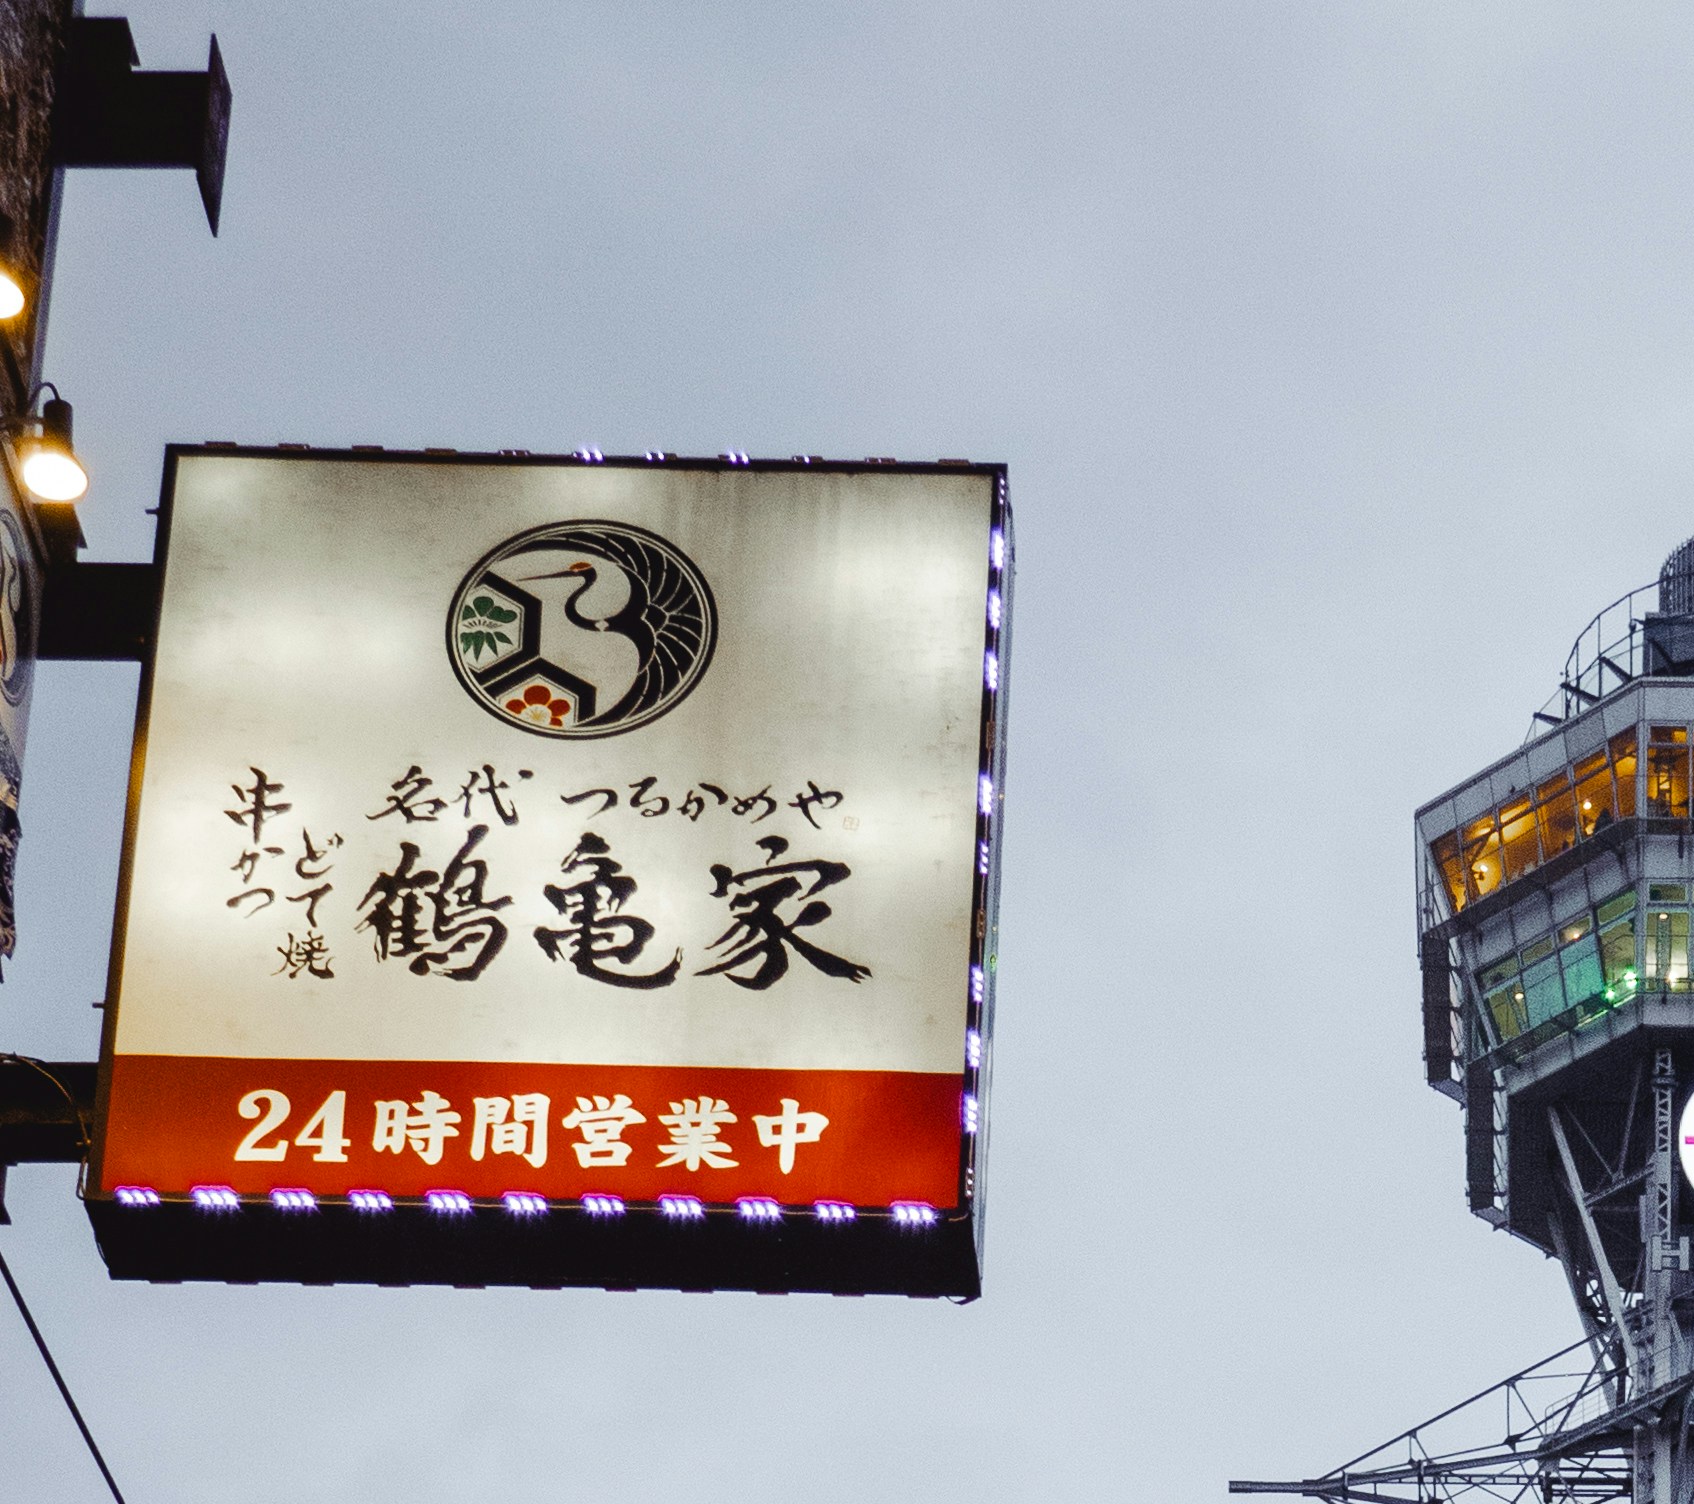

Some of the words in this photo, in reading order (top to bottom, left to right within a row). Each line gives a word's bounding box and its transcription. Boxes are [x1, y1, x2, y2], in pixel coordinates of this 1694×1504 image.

[224, 767, 292, 919] 串かつ
[366, 764, 534, 828] 名代
[561, 778, 846, 831] つるかめや
[274, 826, 344, 981] どて焼
[355, 821, 873, 992] 鶴亀家
[234, 1087, 832, 1176] 24時間営業中
